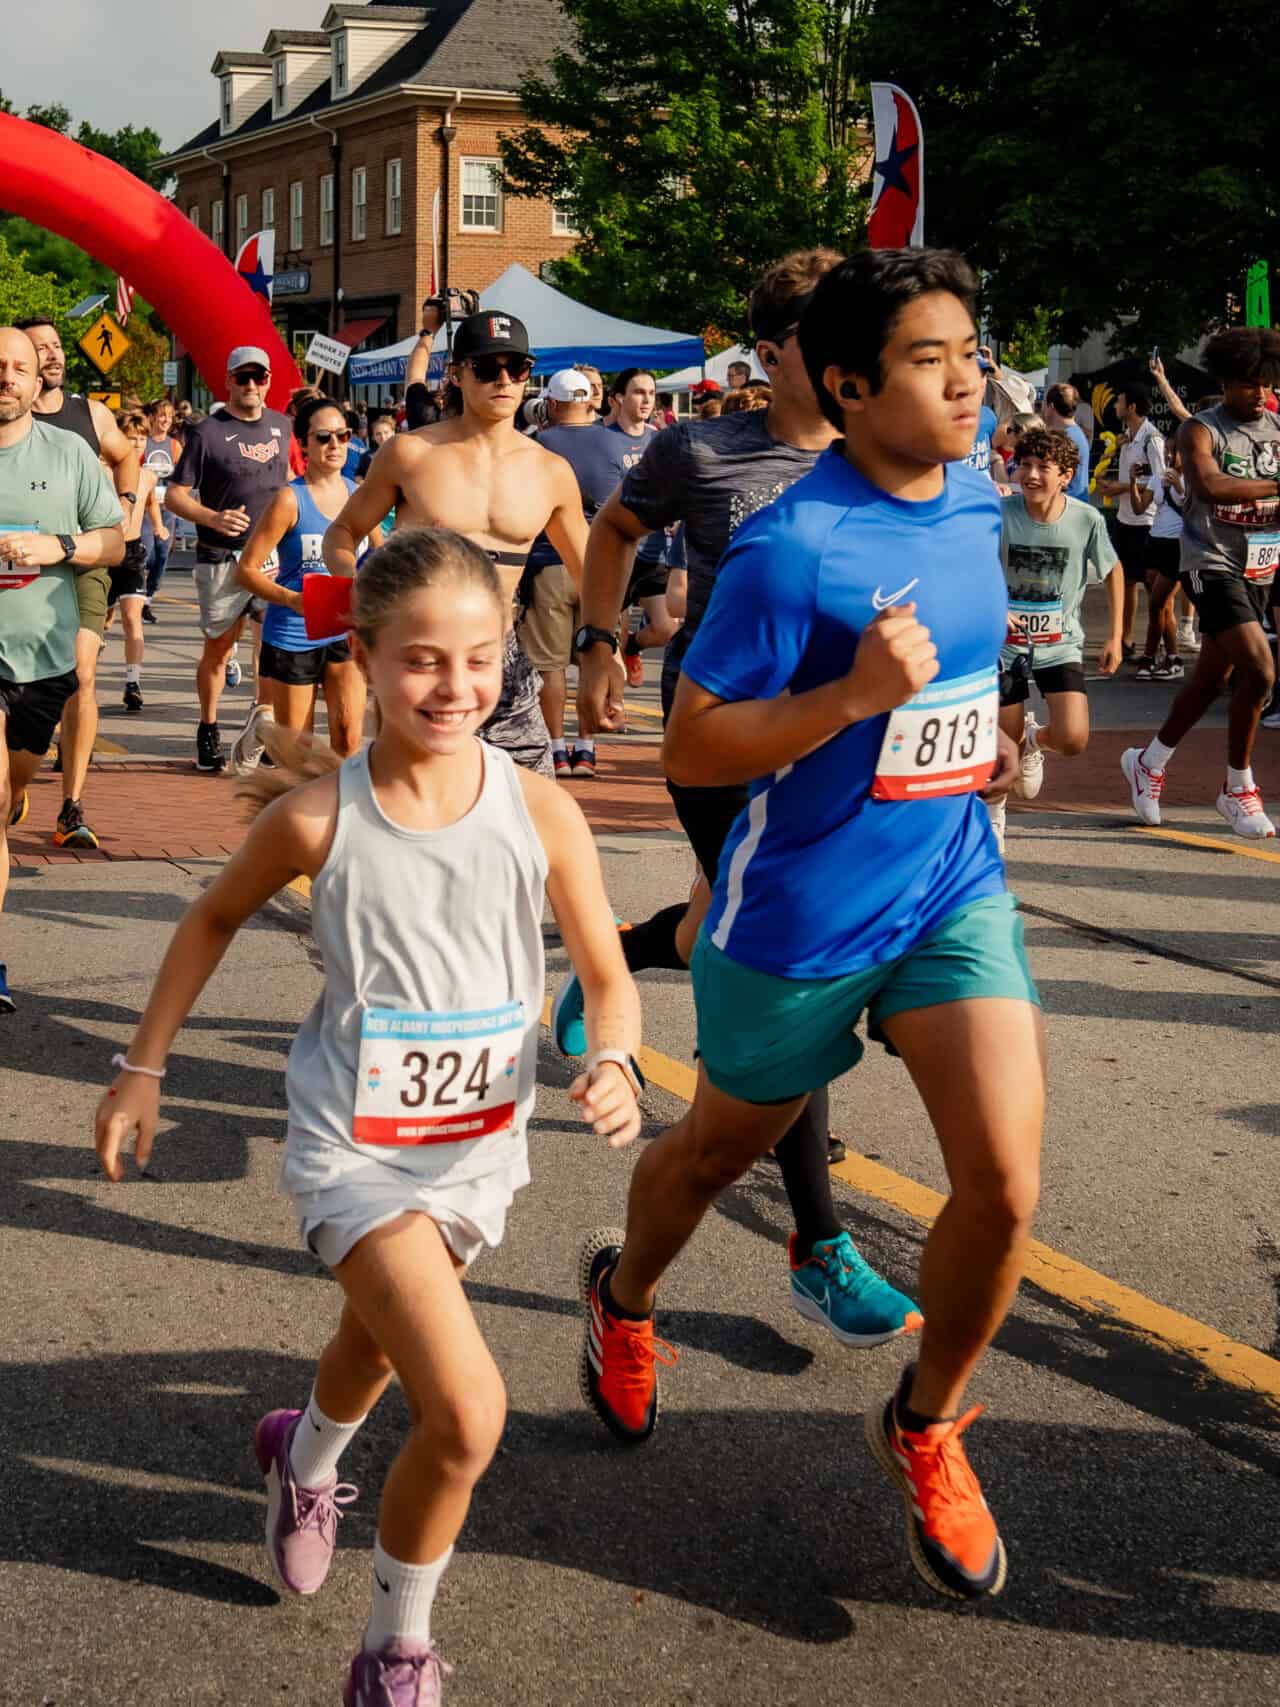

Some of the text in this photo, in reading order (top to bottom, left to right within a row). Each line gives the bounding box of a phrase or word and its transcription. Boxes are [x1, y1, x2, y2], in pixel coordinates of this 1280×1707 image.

[238, 439, 280, 463] USA
[915, 708, 979, 767] 813
[400, 1047, 491, 1107] 324
